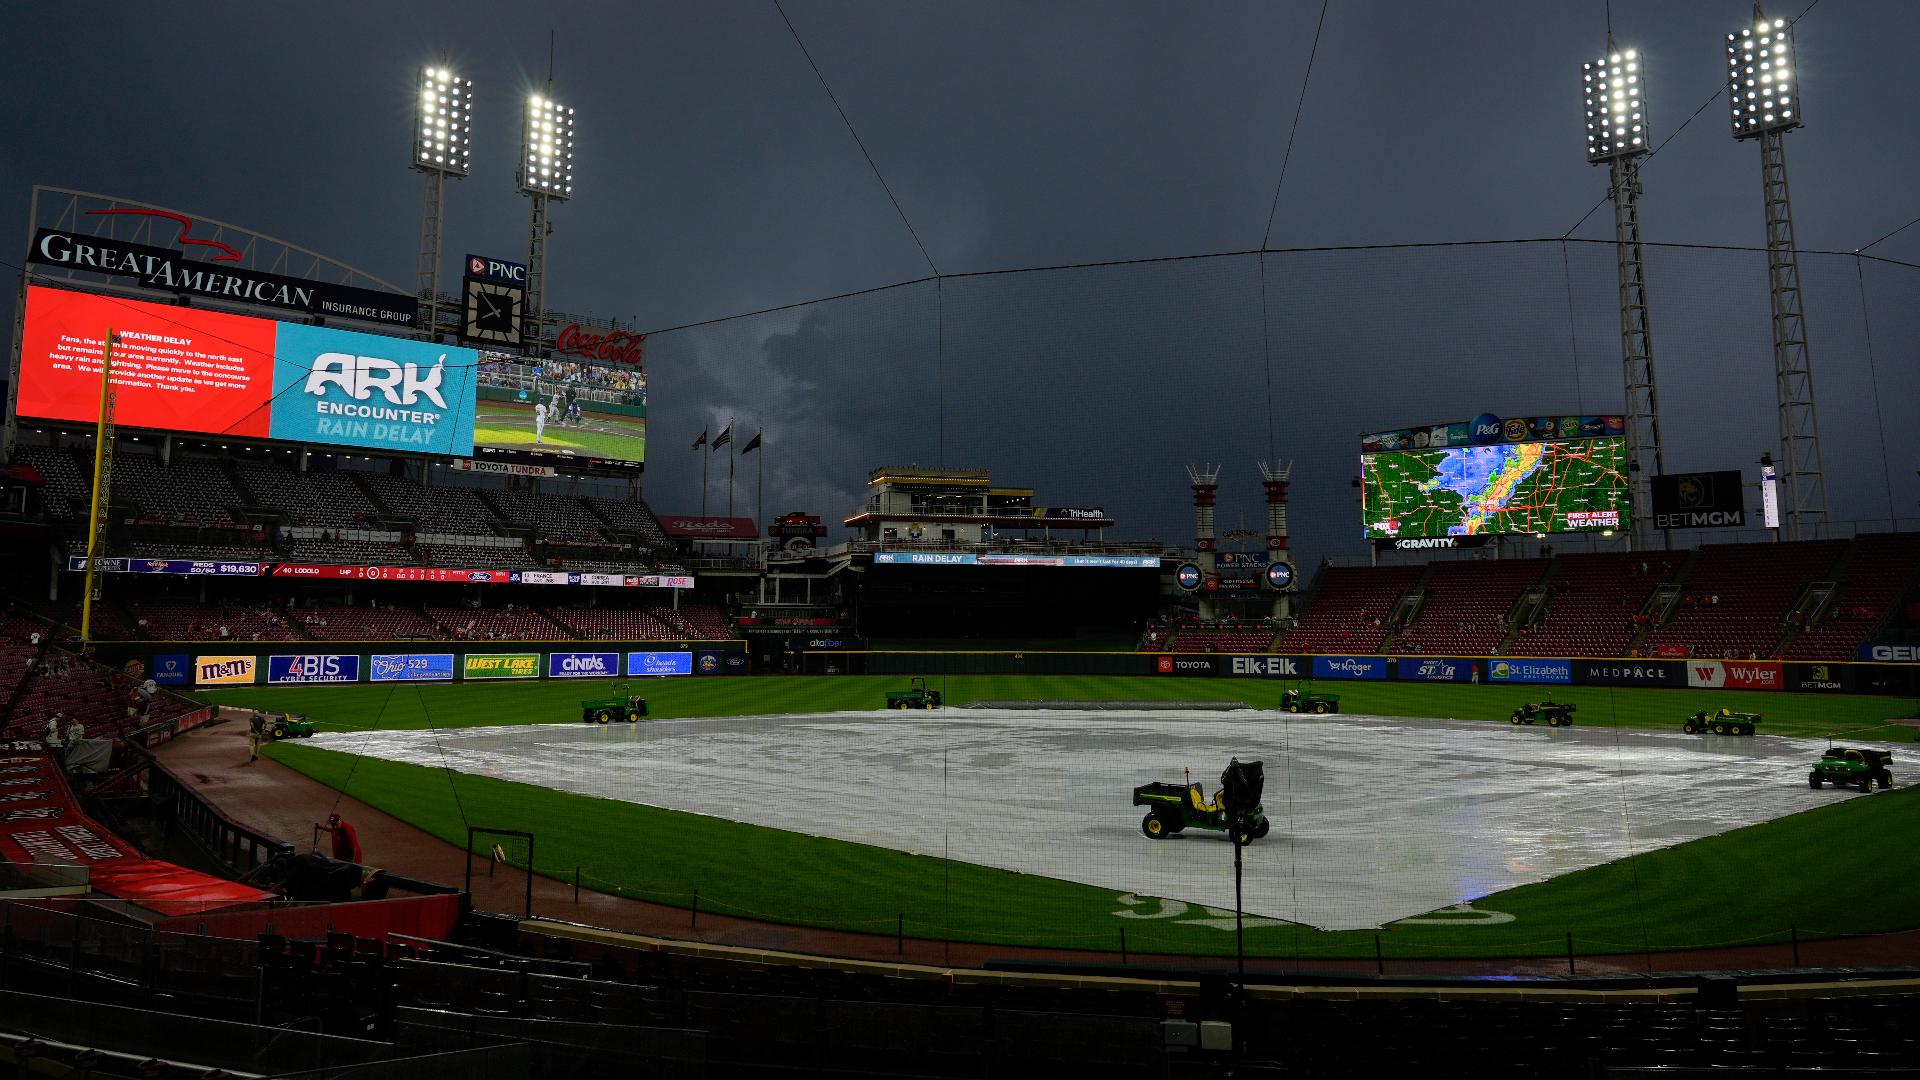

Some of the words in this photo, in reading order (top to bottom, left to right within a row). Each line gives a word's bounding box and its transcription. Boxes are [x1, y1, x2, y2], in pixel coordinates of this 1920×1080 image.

[40, 234, 160, 276] GREAT
[148, 260, 314, 306] AMERICAN
[489, 261, 525, 281] PNC
[322, 300, 377, 319] INSURANCE
[380, 309, 412, 322] GROUP
[120, 331, 162, 342] WEATHER
[164, 336, 192, 345] DELAY
[61, 335, 82, 345] Fans,
[129, 344, 157, 354] moving
[158, 346, 184, 357] quickly
[195, 351, 206, 359] the
[207, 353, 226, 362] north
[227, 355, 243, 363] east
[72, 346, 103, 355] remains
[146, 355, 180, 365] currently.
[184, 359, 214, 369] Weather
[216, 362, 244, 372] includes
[49, 352, 73, 362] heavy
[110, 360, 142, 370] ightning.
[146, 363, 169, 372] Please
[214, 372, 250, 381] concourse
[137, 371, 165, 380] another
[167, 375, 192, 384] update
[304, 352, 447, 409] ARK
[156, 383, 179, 391] Thank
[1476, 419, 1500, 431] P&G
[317, 418, 368, 439] RAIN
[377, 423, 436, 446] DELAY
[475, 462, 509, 473] TOYOTA
[511, 465, 546, 476] TUNDRA
[1069, 509, 1103, 518] TriHealth
[1657, 511, 1740, 527] BETMGM
[672, 520, 735, 531] Reds
[1567, 518, 1619, 527] WEATHER
[1401, 538, 1455, 549] GRAVITY
[935, 555, 963, 563] DELAY
[1233, 553, 1260, 562] PNC
[220, 564, 257, 573] $19,630
[667, 577, 687, 586] ROSE
[1872, 645, 1920, 661] GEI
[289, 656, 341, 678] 4BIS
[408, 659, 429, 670] 529
[466, 658, 503, 670] WEST
[503, 658, 537, 669] LAKE
[1176, 661, 1210, 669] TOYOTA
[1340, 659, 1372, 676] Kroger
[1509, 665, 1521, 675] St.
[1523, 665, 1568, 675] Elizabeth
[511, 668, 533, 676] TIRES
[1589, 666, 1667, 678] MEDPACE
[1730, 667, 1776, 682] Wyler
[1801, 681, 1841, 689] BETMGM
